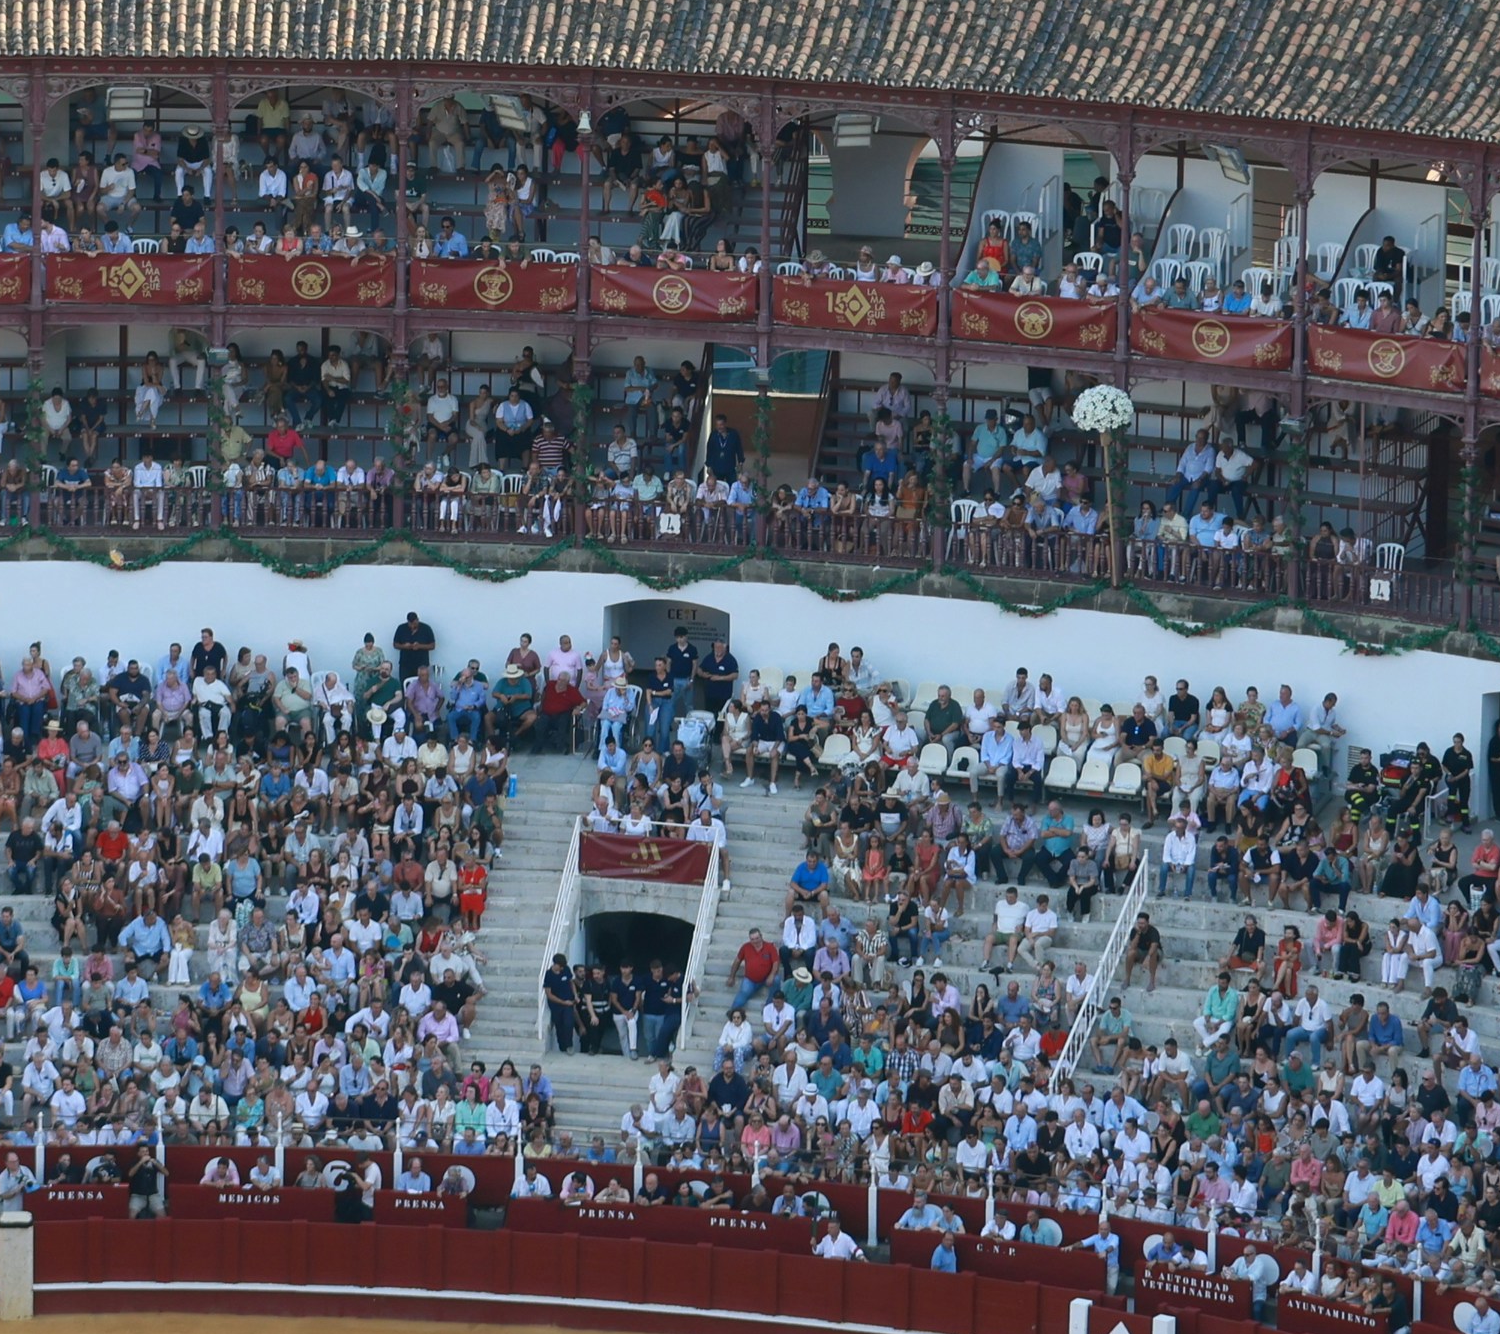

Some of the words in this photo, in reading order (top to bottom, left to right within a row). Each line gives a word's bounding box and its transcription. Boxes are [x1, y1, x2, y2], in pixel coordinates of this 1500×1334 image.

[49, 1190, 104, 1201] PRENSA
[219, 1193, 280, 1204] MEDICOS
[395, 1198, 445, 1210] PRENSA
[579, 1208, 635, 1220] PRENSA
[710, 1217, 767, 1230] PRENSA
[1158, 1272, 1229, 1292] AUTORIDAD
[1142, 1278, 1235, 1303] VETERINARIOS
[1287, 1299, 1376, 1327] AYUNTAMIENTO
